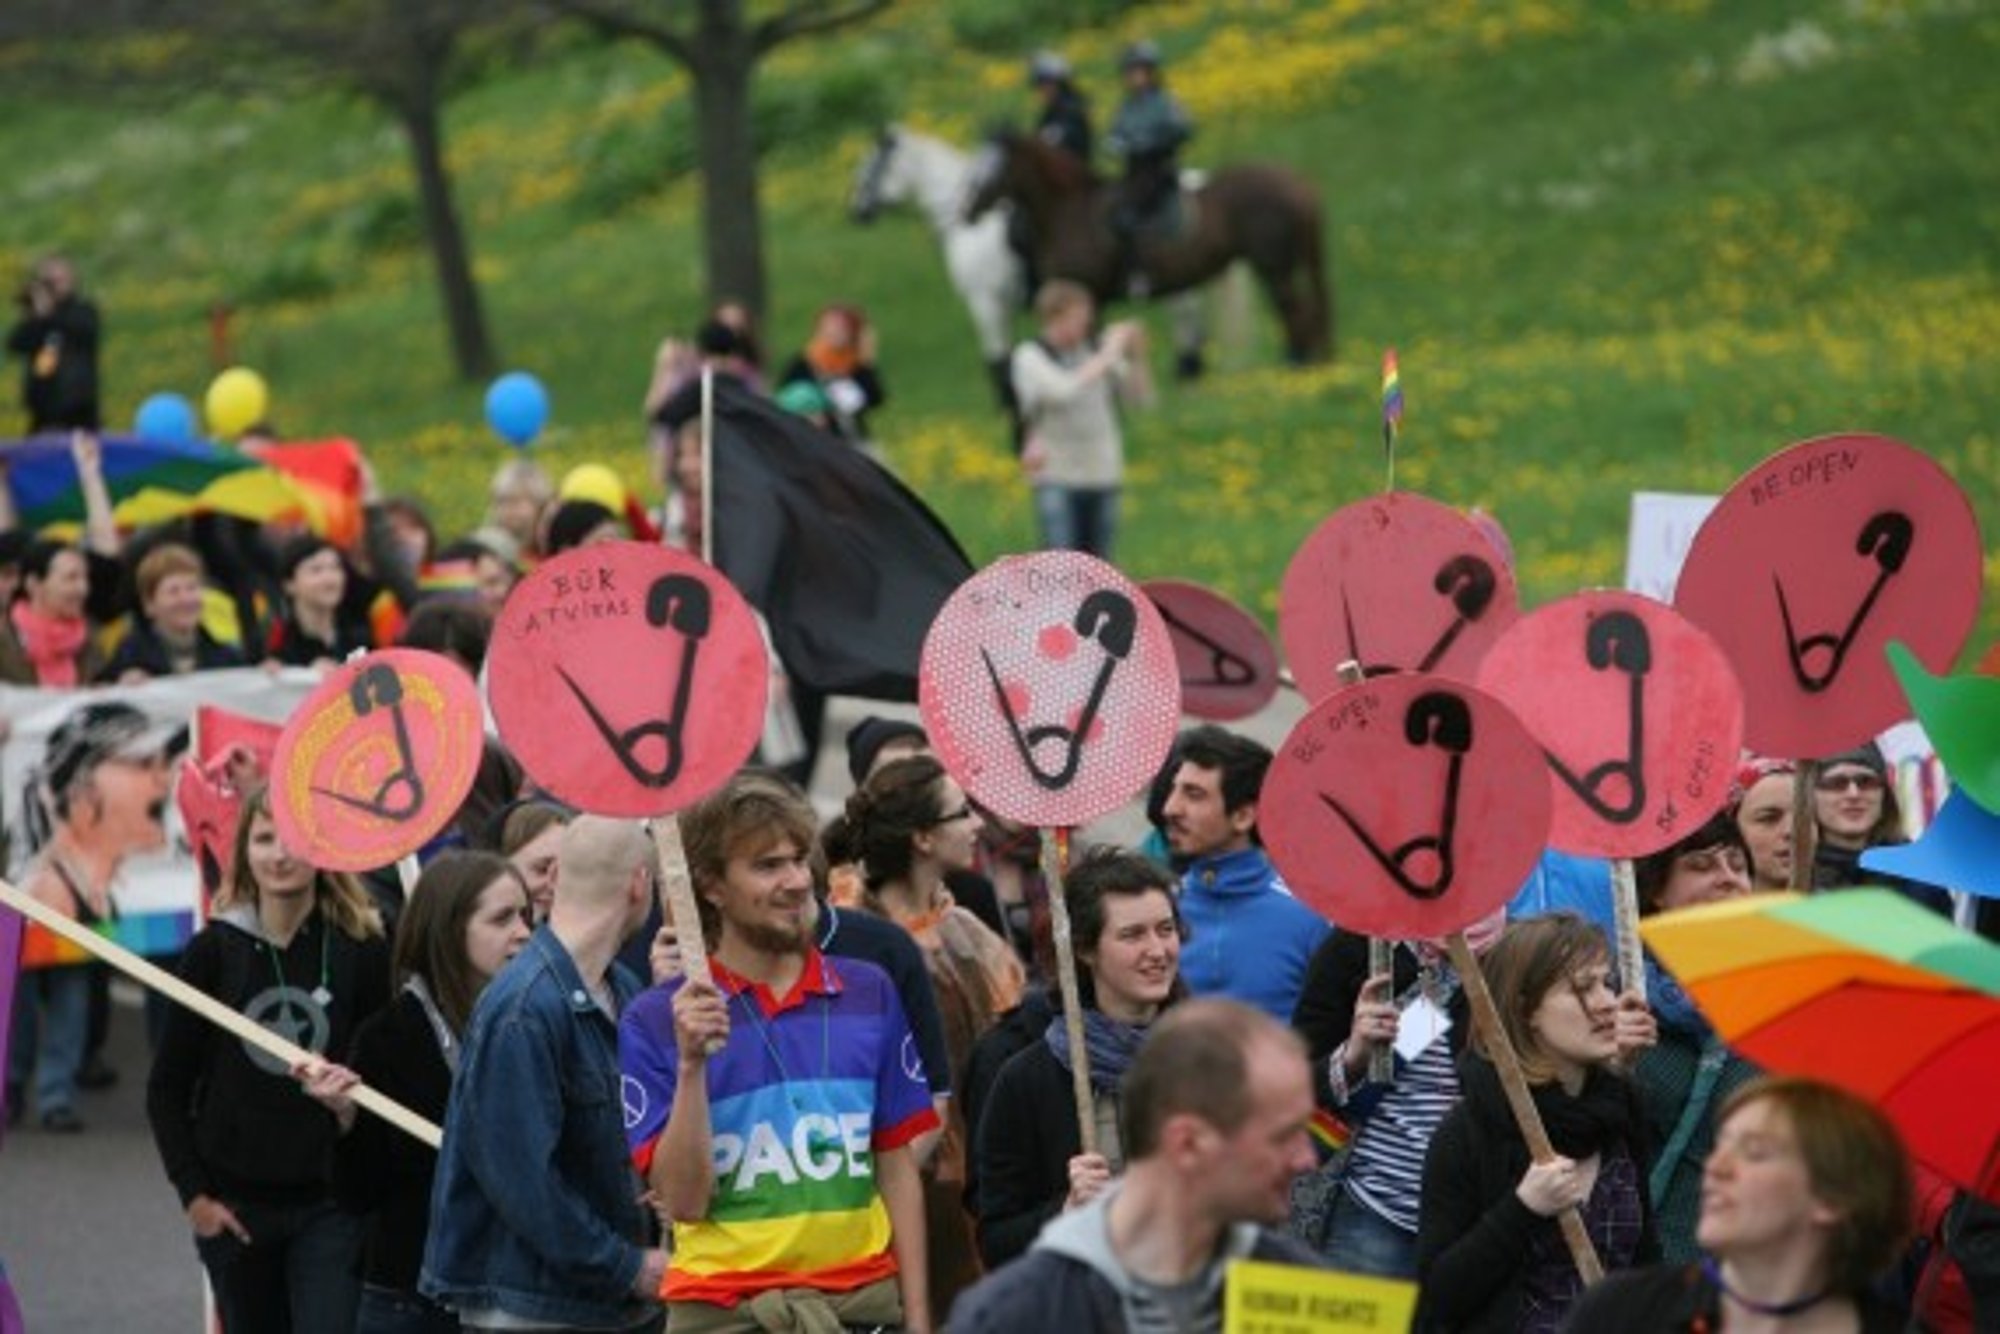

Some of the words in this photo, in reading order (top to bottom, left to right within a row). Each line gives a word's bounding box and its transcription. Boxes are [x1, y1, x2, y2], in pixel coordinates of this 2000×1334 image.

[1750, 473, 1781, 505] BE
[1789, 449, 1861, 486] OPEN
[1328, 693, 1381, 731] OPEN
[1685, 740, 1714, 798] OPEN
[711, 1111, 873, 1192] PACE
